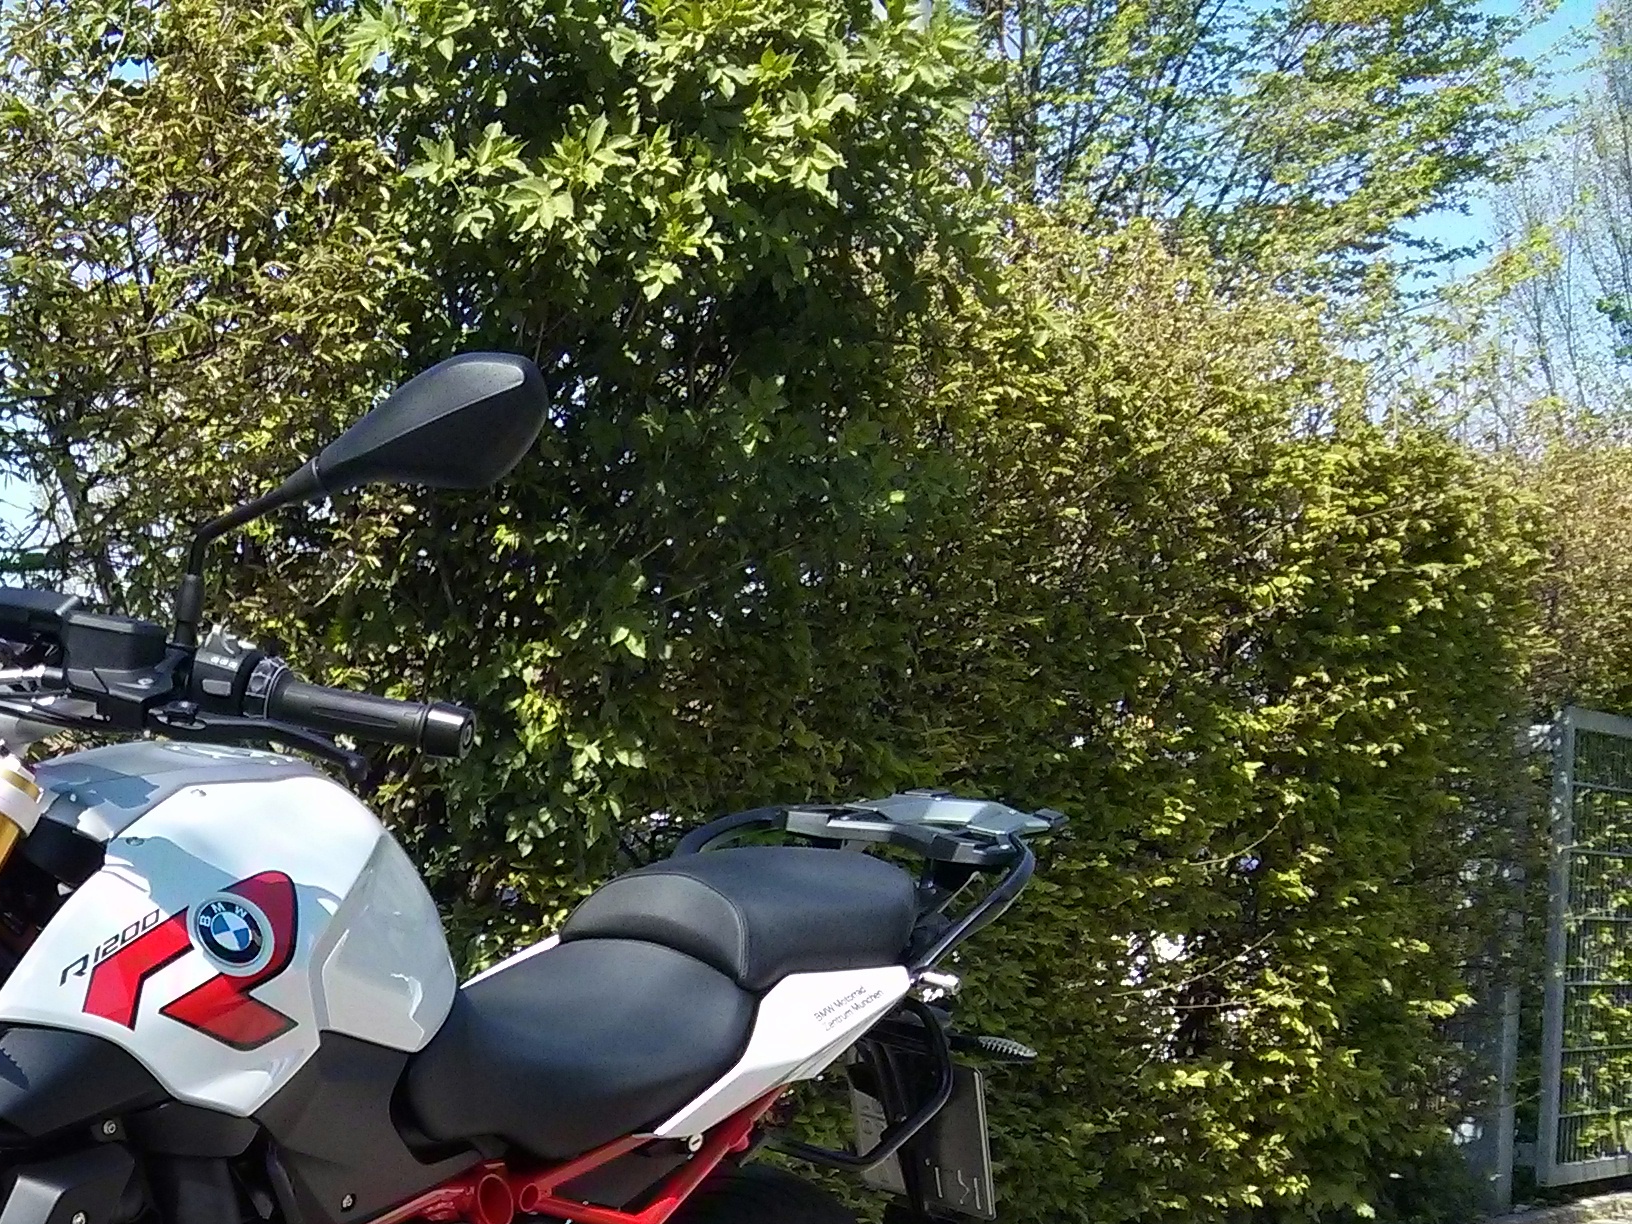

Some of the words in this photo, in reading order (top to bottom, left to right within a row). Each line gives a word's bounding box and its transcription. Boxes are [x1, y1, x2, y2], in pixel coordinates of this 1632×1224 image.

[199, 902, 247, 928] BMW
[59, 909, 159, 986] R1200
[814, 1004, 835, 1021] BMW
[833, 985, 866, 1007] Motorrad
[823, 1009, 853, 1031] Zentrum
